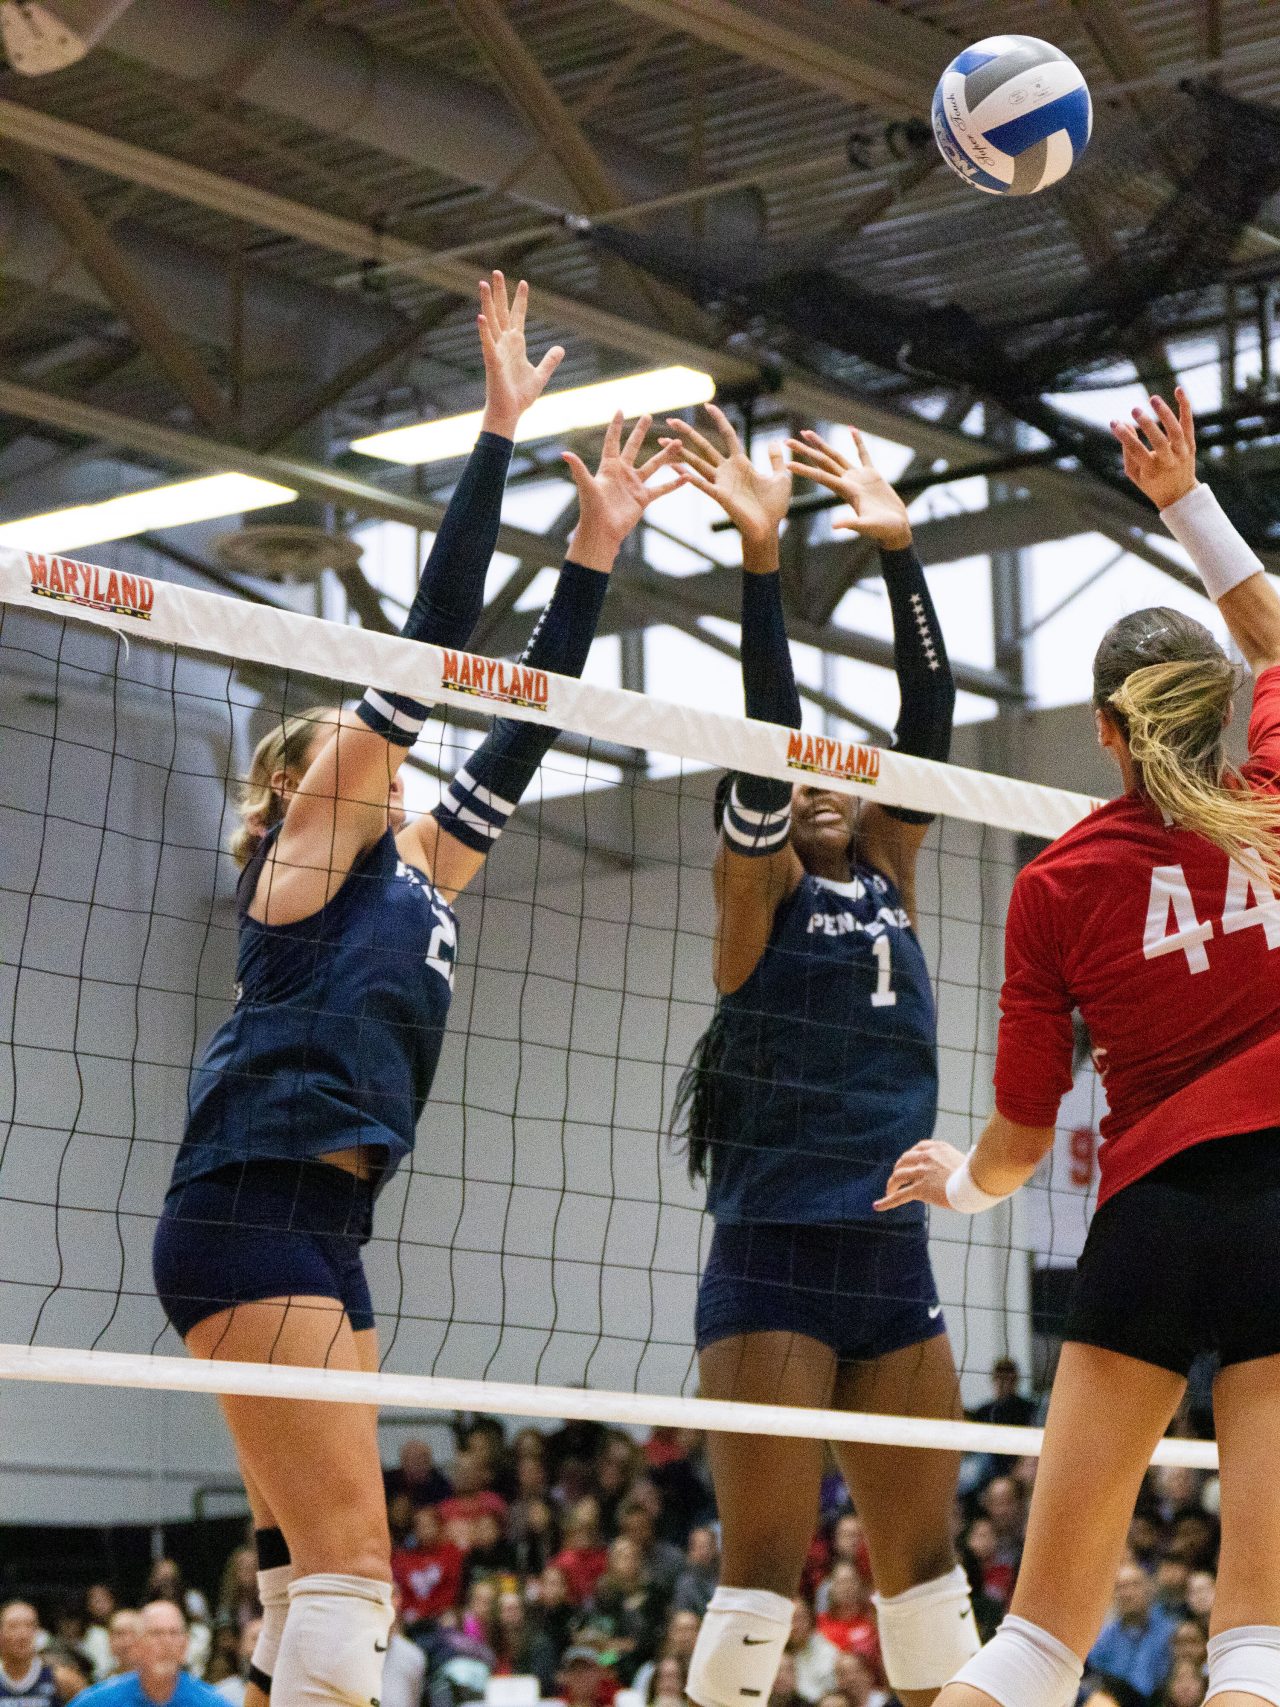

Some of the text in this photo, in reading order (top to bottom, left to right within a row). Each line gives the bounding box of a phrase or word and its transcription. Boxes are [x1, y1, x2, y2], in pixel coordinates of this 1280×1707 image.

[946, 92, 967, 133] Touch
[26, 552, 155, 612] MARYLAND
[441, 649, 549, 704] MARYLAND
[786, 729, 880, 779] MARYLAND
[870, 934, 896, 1007] 1
